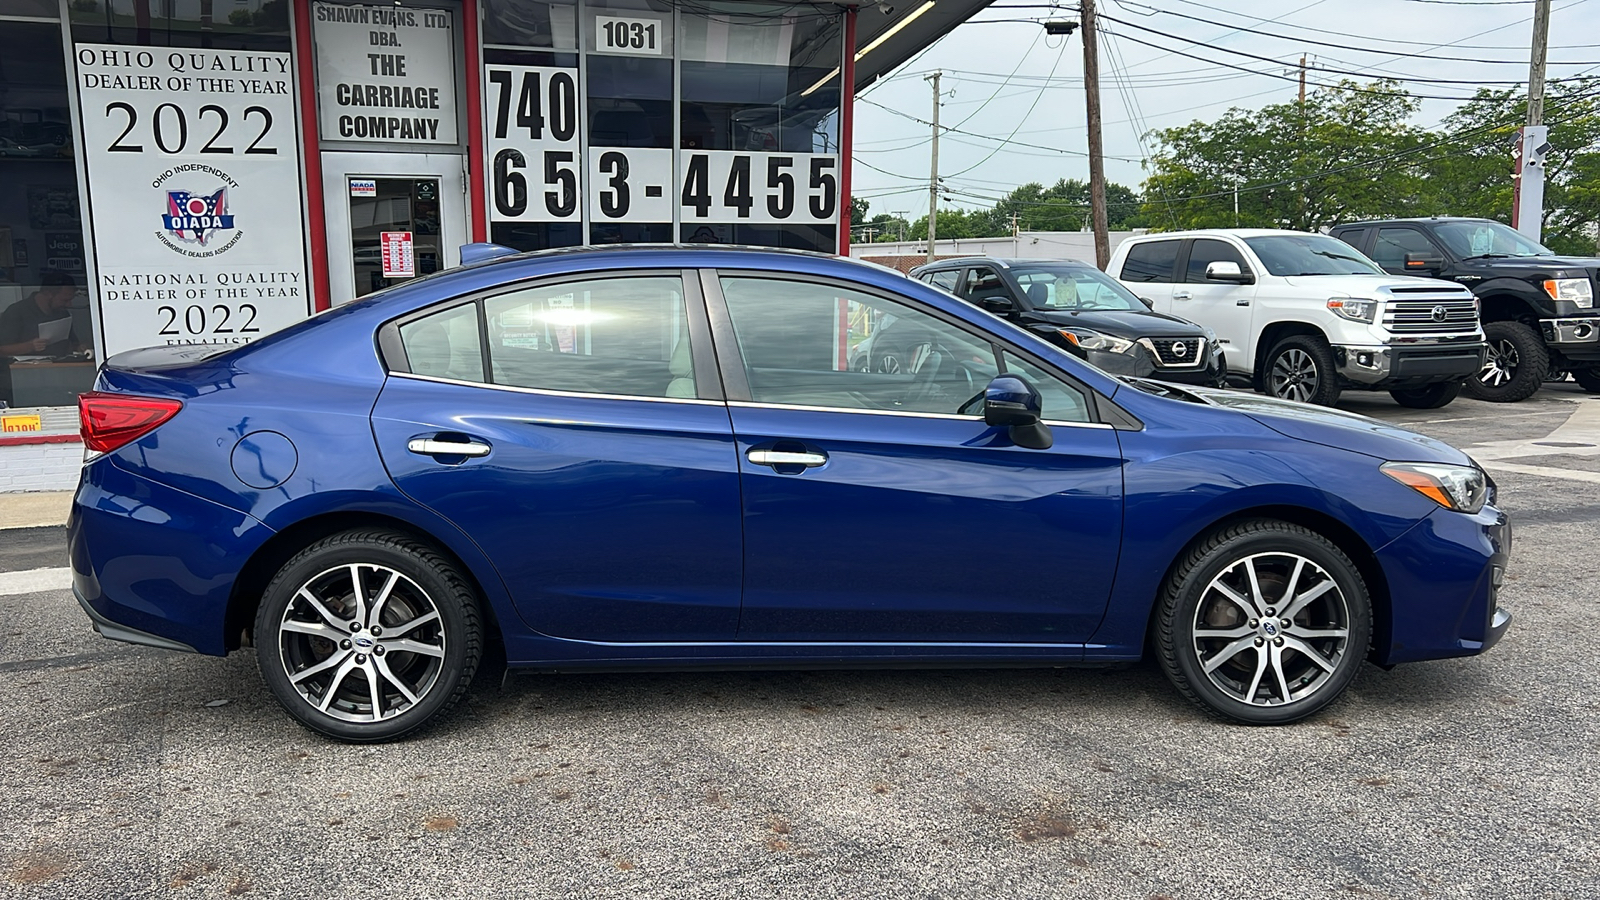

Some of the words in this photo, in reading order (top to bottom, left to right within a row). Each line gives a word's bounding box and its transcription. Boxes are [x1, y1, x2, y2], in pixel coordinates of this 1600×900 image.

[316, 6, 369, 24] SHAWN
[424, 13, 450, 29] LTD.
[369, 31, 401, 47] DBA.
[602, 21, 656, 49] 1031
[78, 49, 154, 68] OHIO
[168, 53, 289, 73] QUALITY
[367, 54, 406, 77] THE
[83, 73, 162, 91] DEALER
[167, 77, 192, 92] OF
[196, 78, 235, 93] THE
[239, 79, 288, 95] YEAR
[336, 83, 440, 109] CARRIAGE
[489, 70, 576, 142] 740
[105, 102, 278, 155] 2022
[339, 115, 440, 140] COMPANY
[152, 169, 174, 189] OHIO
[173, 163, 240, 189] INDEPENDENT
[171, 216, 223, 229] OIADA
[48, 239, 78, 251] Jeep
[154, 231, 187, 256] AUTOMOBILE
[187, 250, 214, 258] DEALERS
[214, 229, 244, 256] ASSOCIATION
[102, 273, 208, 286] NATIONAL
[217, 272, 301, 285] QUALITY
[107, 289, 177, 301] DEALER
[186, 289, 207, 299] OF
[214, 288, 249, 299] THE
[256, 287, 300, 298] YEAR
[157, 303, 260, 336] 2022
